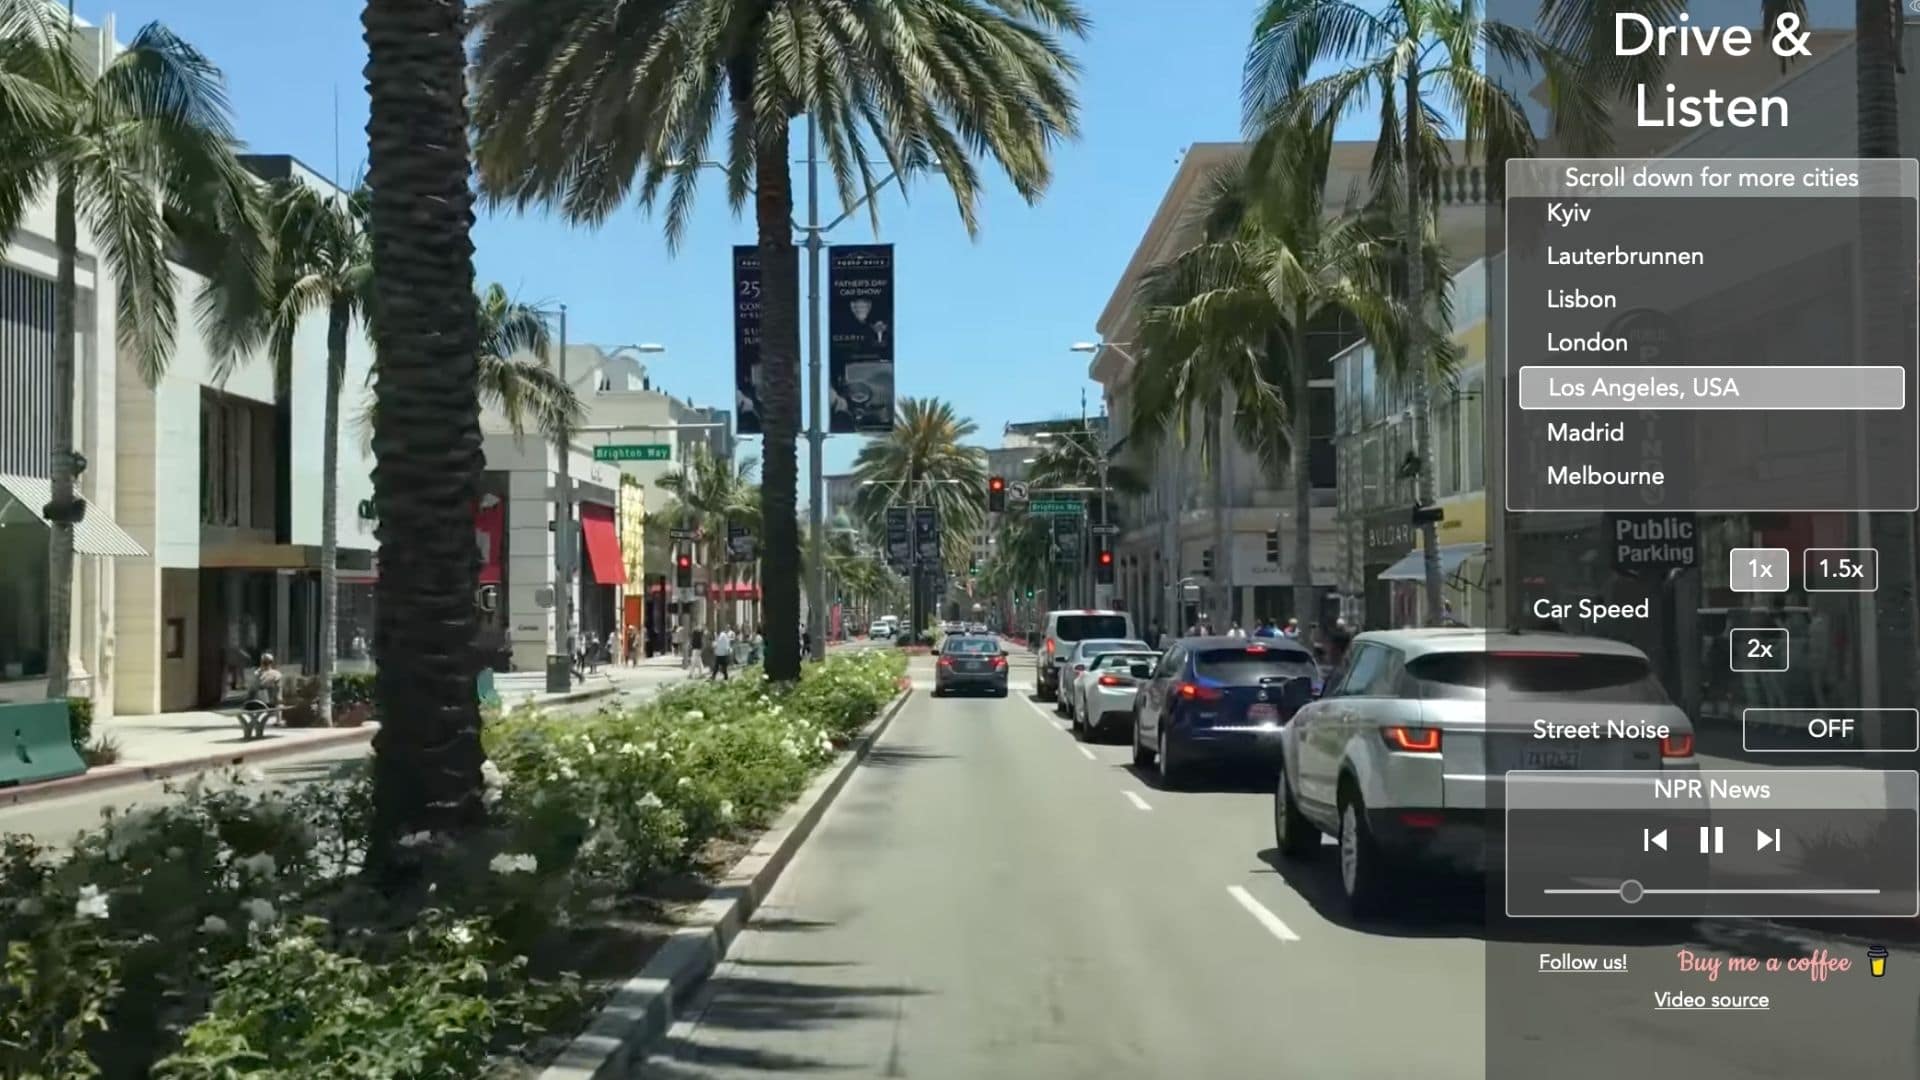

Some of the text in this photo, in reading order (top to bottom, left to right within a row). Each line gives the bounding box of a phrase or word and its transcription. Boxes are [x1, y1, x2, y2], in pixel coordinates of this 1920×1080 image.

[596, 448, 668, 459] Brighton Way
[1616, 519, 1694, 541] Public
[1617, 544, 1695, 564] Parking
